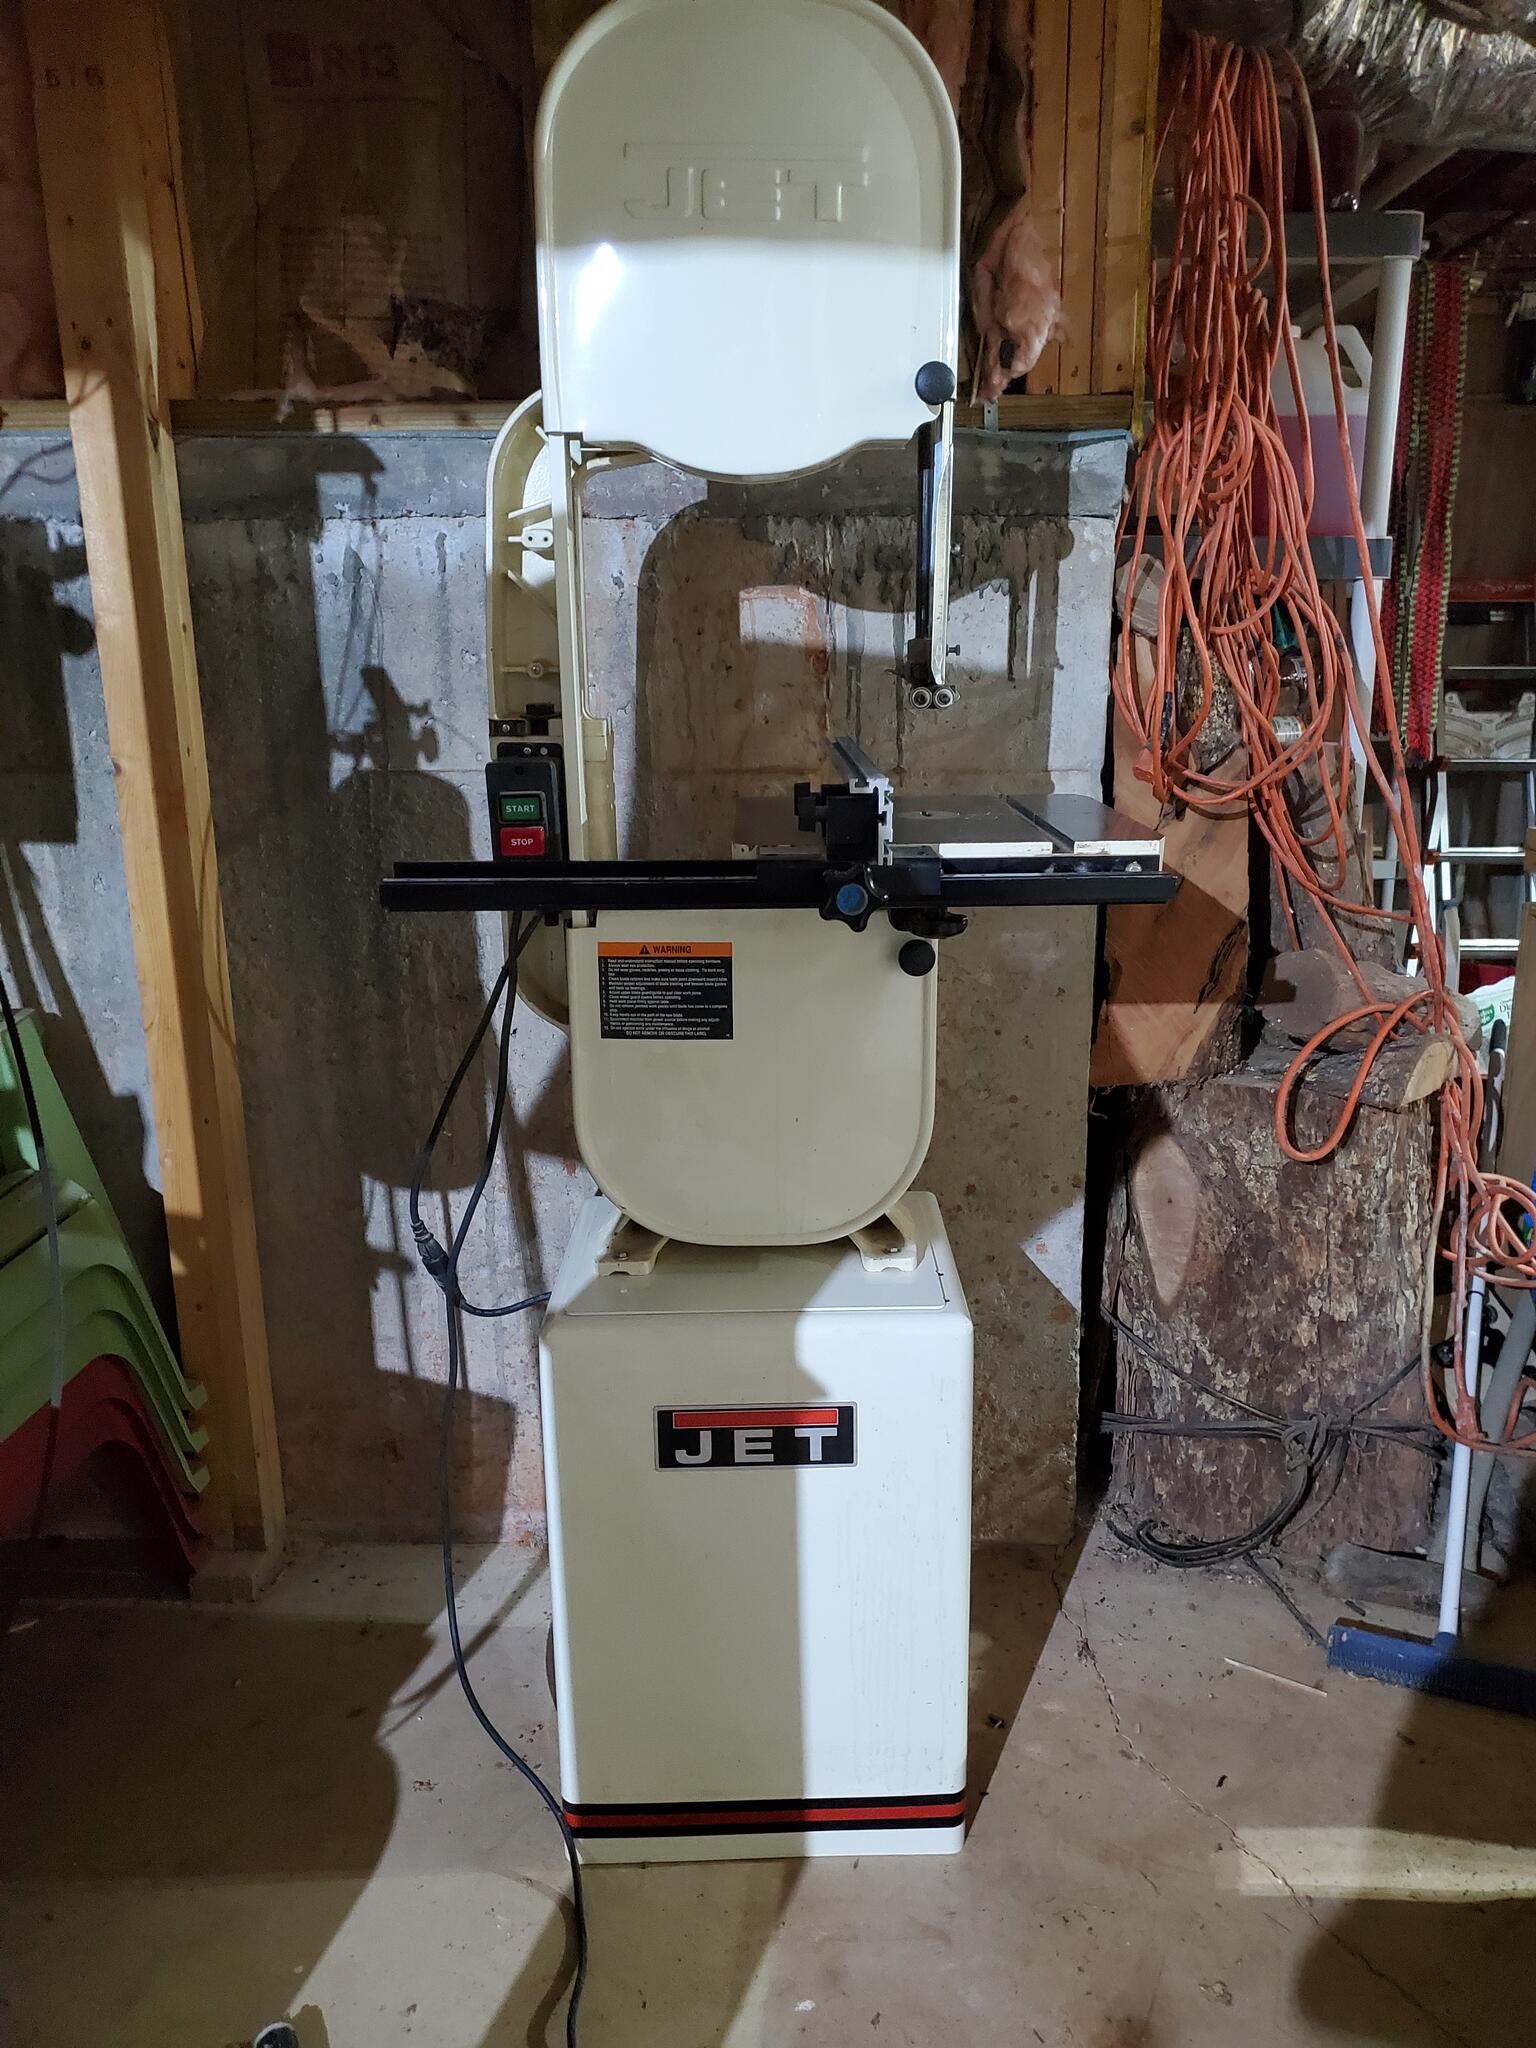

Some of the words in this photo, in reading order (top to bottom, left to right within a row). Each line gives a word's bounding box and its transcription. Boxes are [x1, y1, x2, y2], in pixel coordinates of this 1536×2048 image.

[624, 166, 869, 223] JET
[505, 805, 535, 813] START
[511, 838, 534, 846] STOP
[653, 945, 692, 954] WARNING
[675, 1427, 838, 1465] JET
